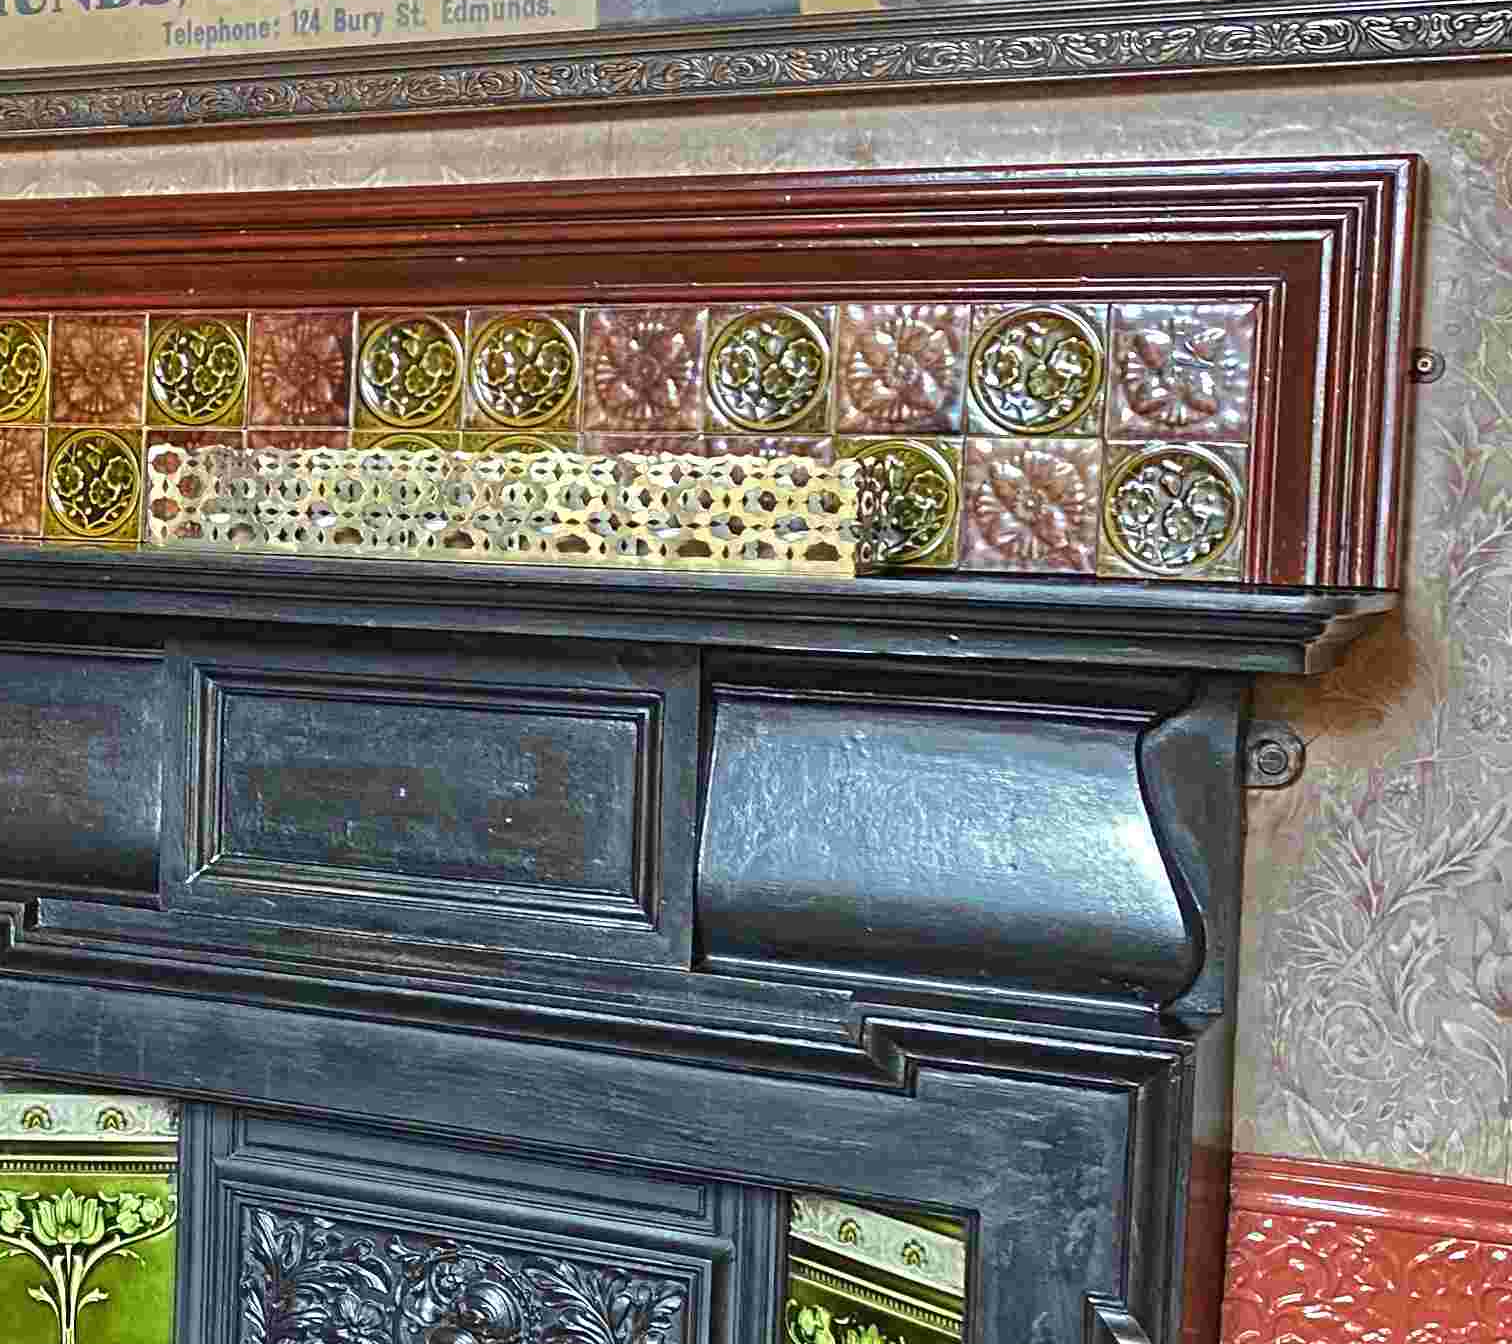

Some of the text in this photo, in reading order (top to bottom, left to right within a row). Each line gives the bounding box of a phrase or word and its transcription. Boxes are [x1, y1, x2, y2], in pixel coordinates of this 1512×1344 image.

[164, 18, 280, 51] Telephone:
[290, 7, 322, 33] 124
[334, 6, 385, 38] Bury
[396, 2, 426, 27] St.
